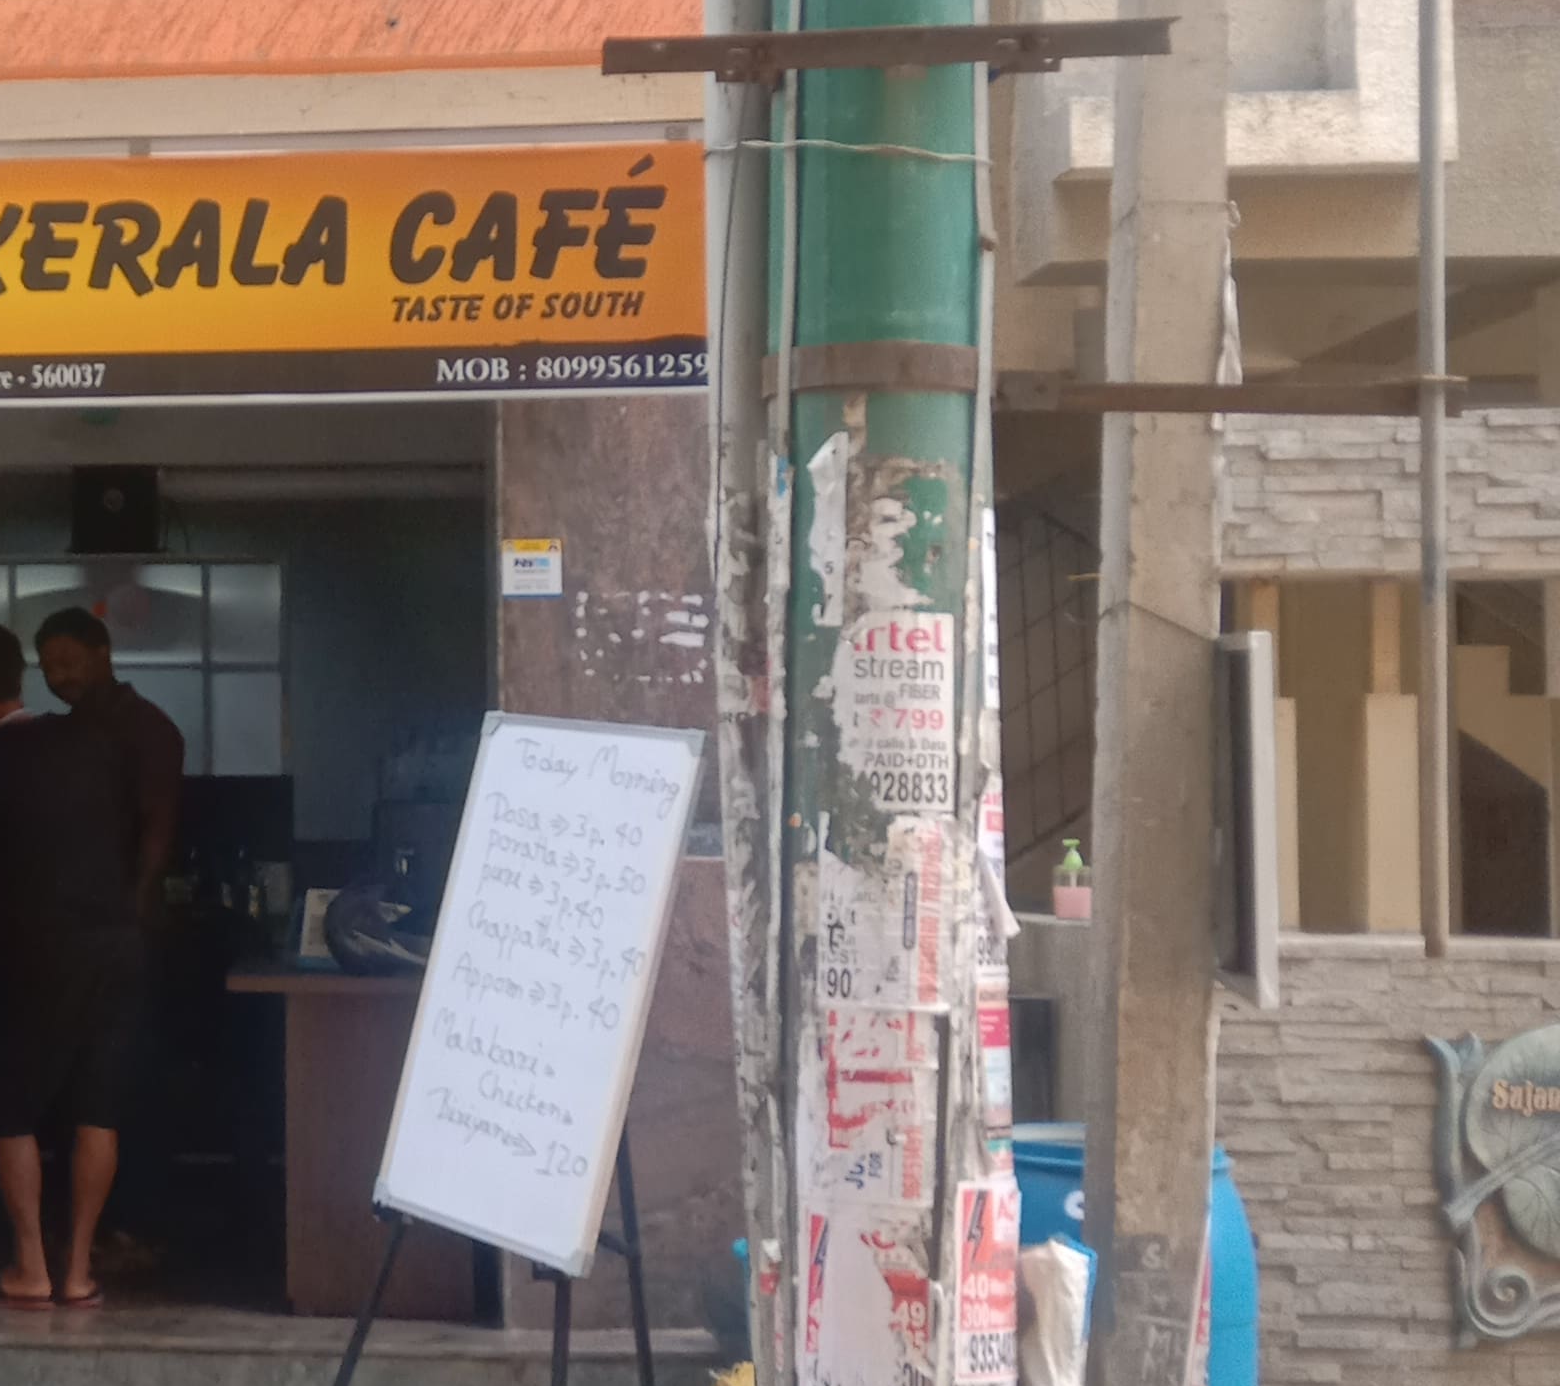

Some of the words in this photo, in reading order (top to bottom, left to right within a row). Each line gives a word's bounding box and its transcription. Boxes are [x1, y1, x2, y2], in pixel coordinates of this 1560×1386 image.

[388, 155, 668, 287] CAFÉ
[392, 294, 483, 322] TASTE
[493, 293, 534, 320] OF
[540, 291, 645, 318] SOUTH
[31, 363, 106, 389] 560037
[437, 358, 509, 383] MOB
[536, 353, 710, 381] 8099561259
[853, 620, 946, 653] rtel
[854, 656, 944, 681] stream
[899, 683, 941, 700] FIBER
[893, 709, 944, 729] 799
[515, 738, 578, 787] Today
[588, 744, 680, 821] Morning
[485, 791, 539, 831] Dosa
[615, 864, 646, 895] 50
[575, 900, 604, 930] 40
[589, 995, 621, 1031] 40
[536, 1140, 589, 1177] 120
